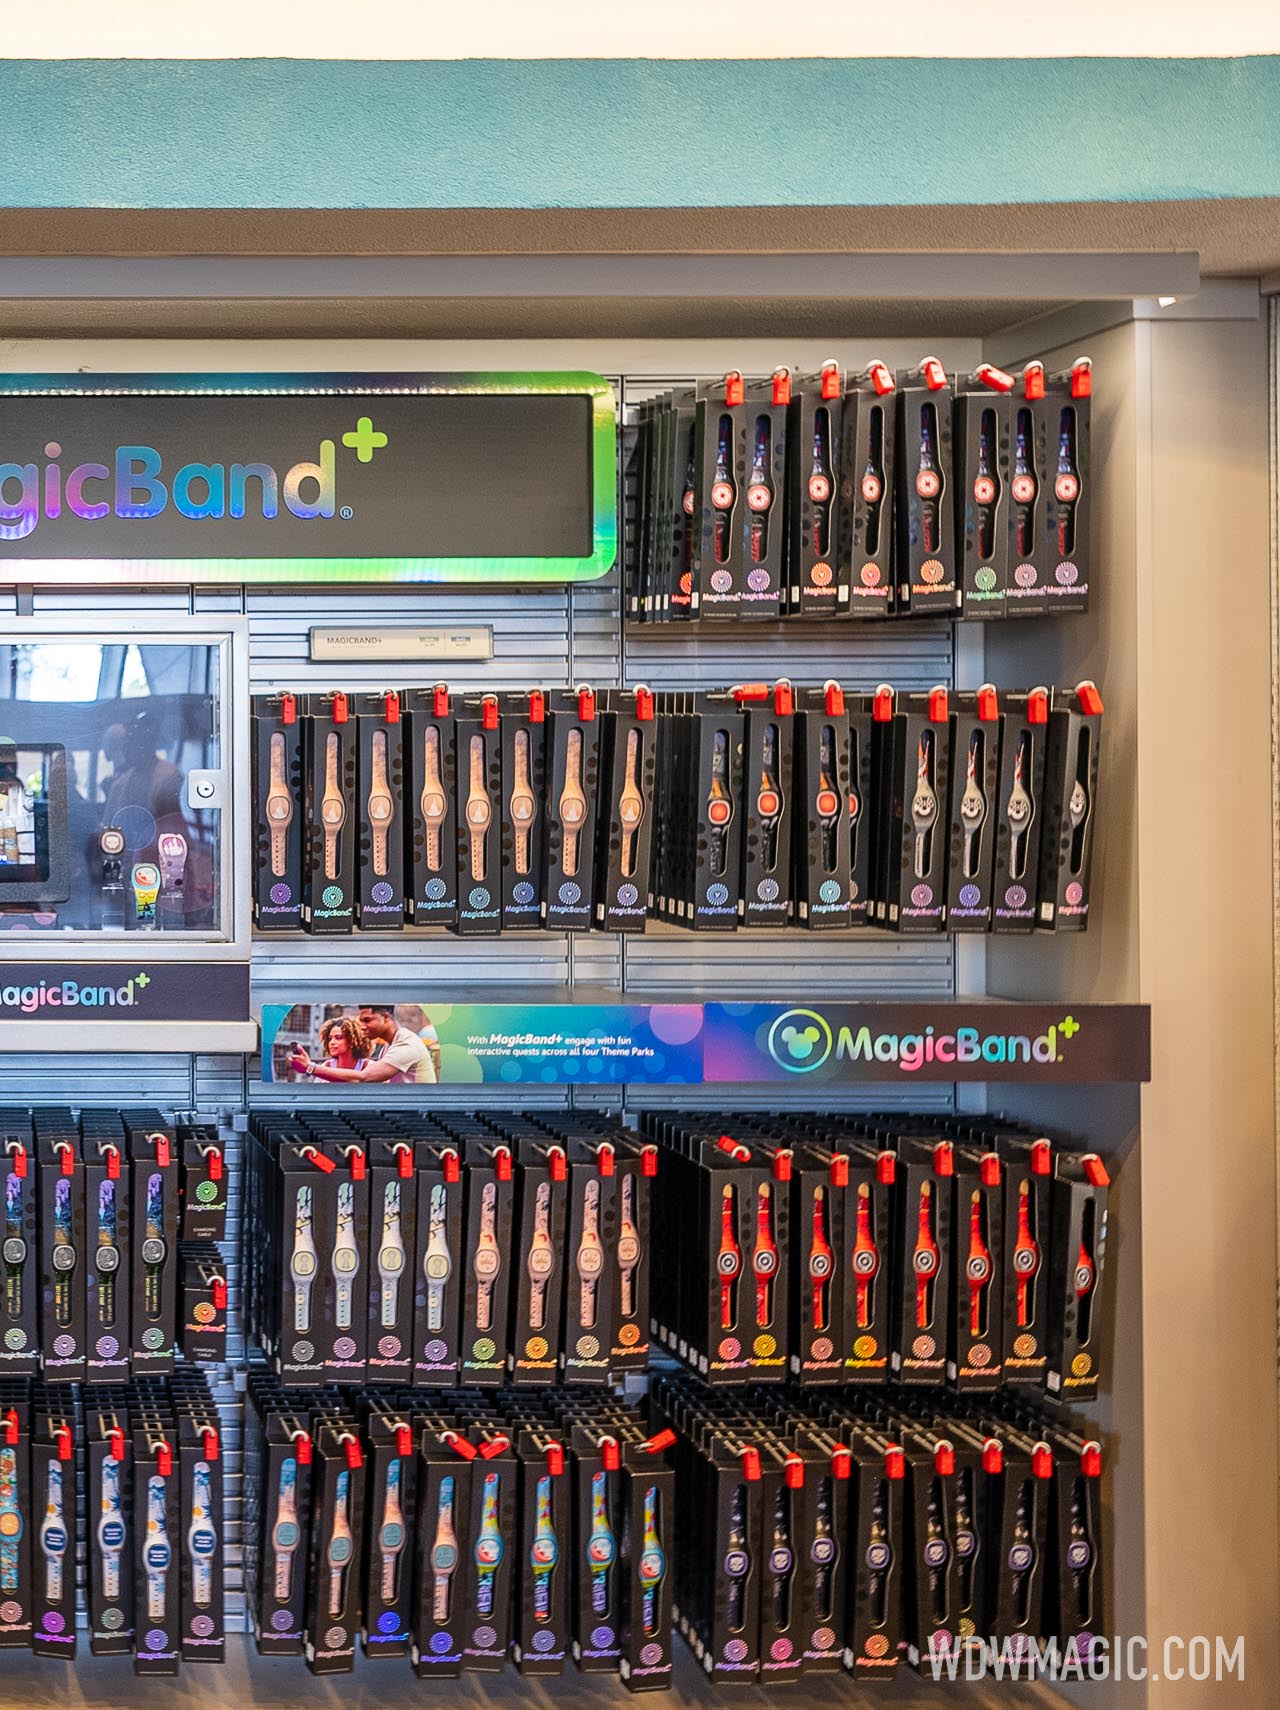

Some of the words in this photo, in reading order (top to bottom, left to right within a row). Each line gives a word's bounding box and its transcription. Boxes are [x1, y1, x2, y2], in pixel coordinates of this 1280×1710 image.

[327, 636, 382, 644] MAGICBAND+
[467, 1036, 488, 1044] With
[564, 1037, 596, 1047] engage
[597, 1036, 616, 1045] with
[617, 1036, 632, 1045] fun
[467, 1047, 511, 1056] interactive
[512, 1048, 540, 1057] quests
[541, 1048, 568, 1056] across
[569, 1047, 581, 1056] all
[582, 1047, 600, 1056] four
[601, 1047, 630, 1056] Theme
[631, 1047, 655, 1056] Parks
